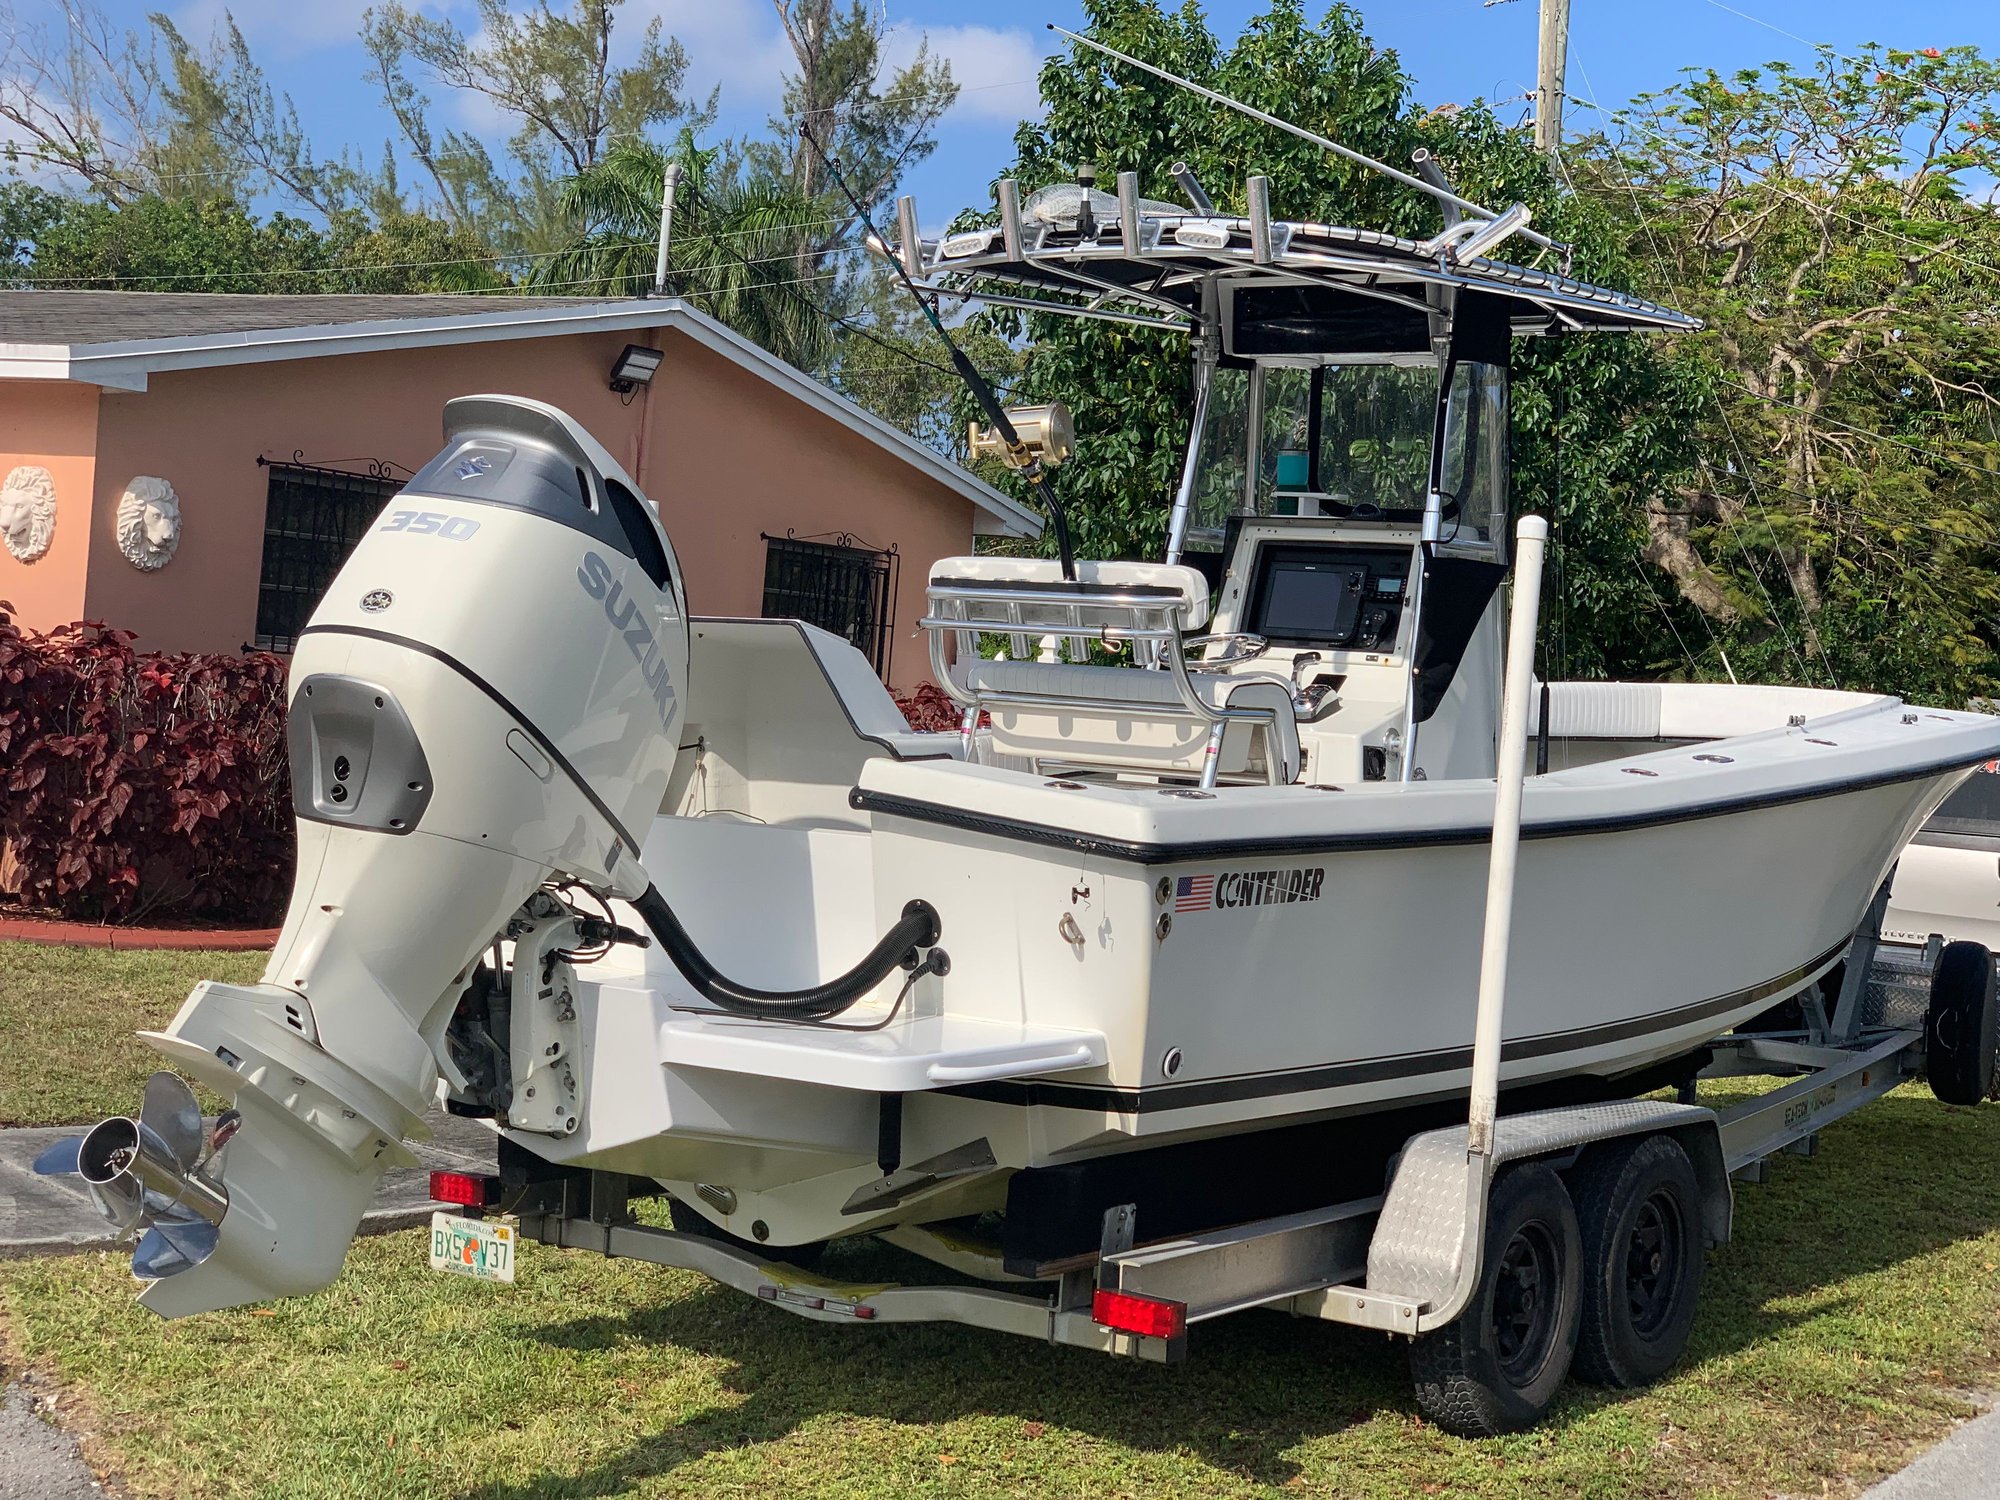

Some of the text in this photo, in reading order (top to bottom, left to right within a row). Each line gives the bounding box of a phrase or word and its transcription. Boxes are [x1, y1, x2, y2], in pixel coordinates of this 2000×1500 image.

[379, 510, 481, 541] 350
[576, 551, 678, 734] SUZUKI
[1215, 867, 1325, 909] CONTENDER
[480, 1238, 507, 1270] V37
